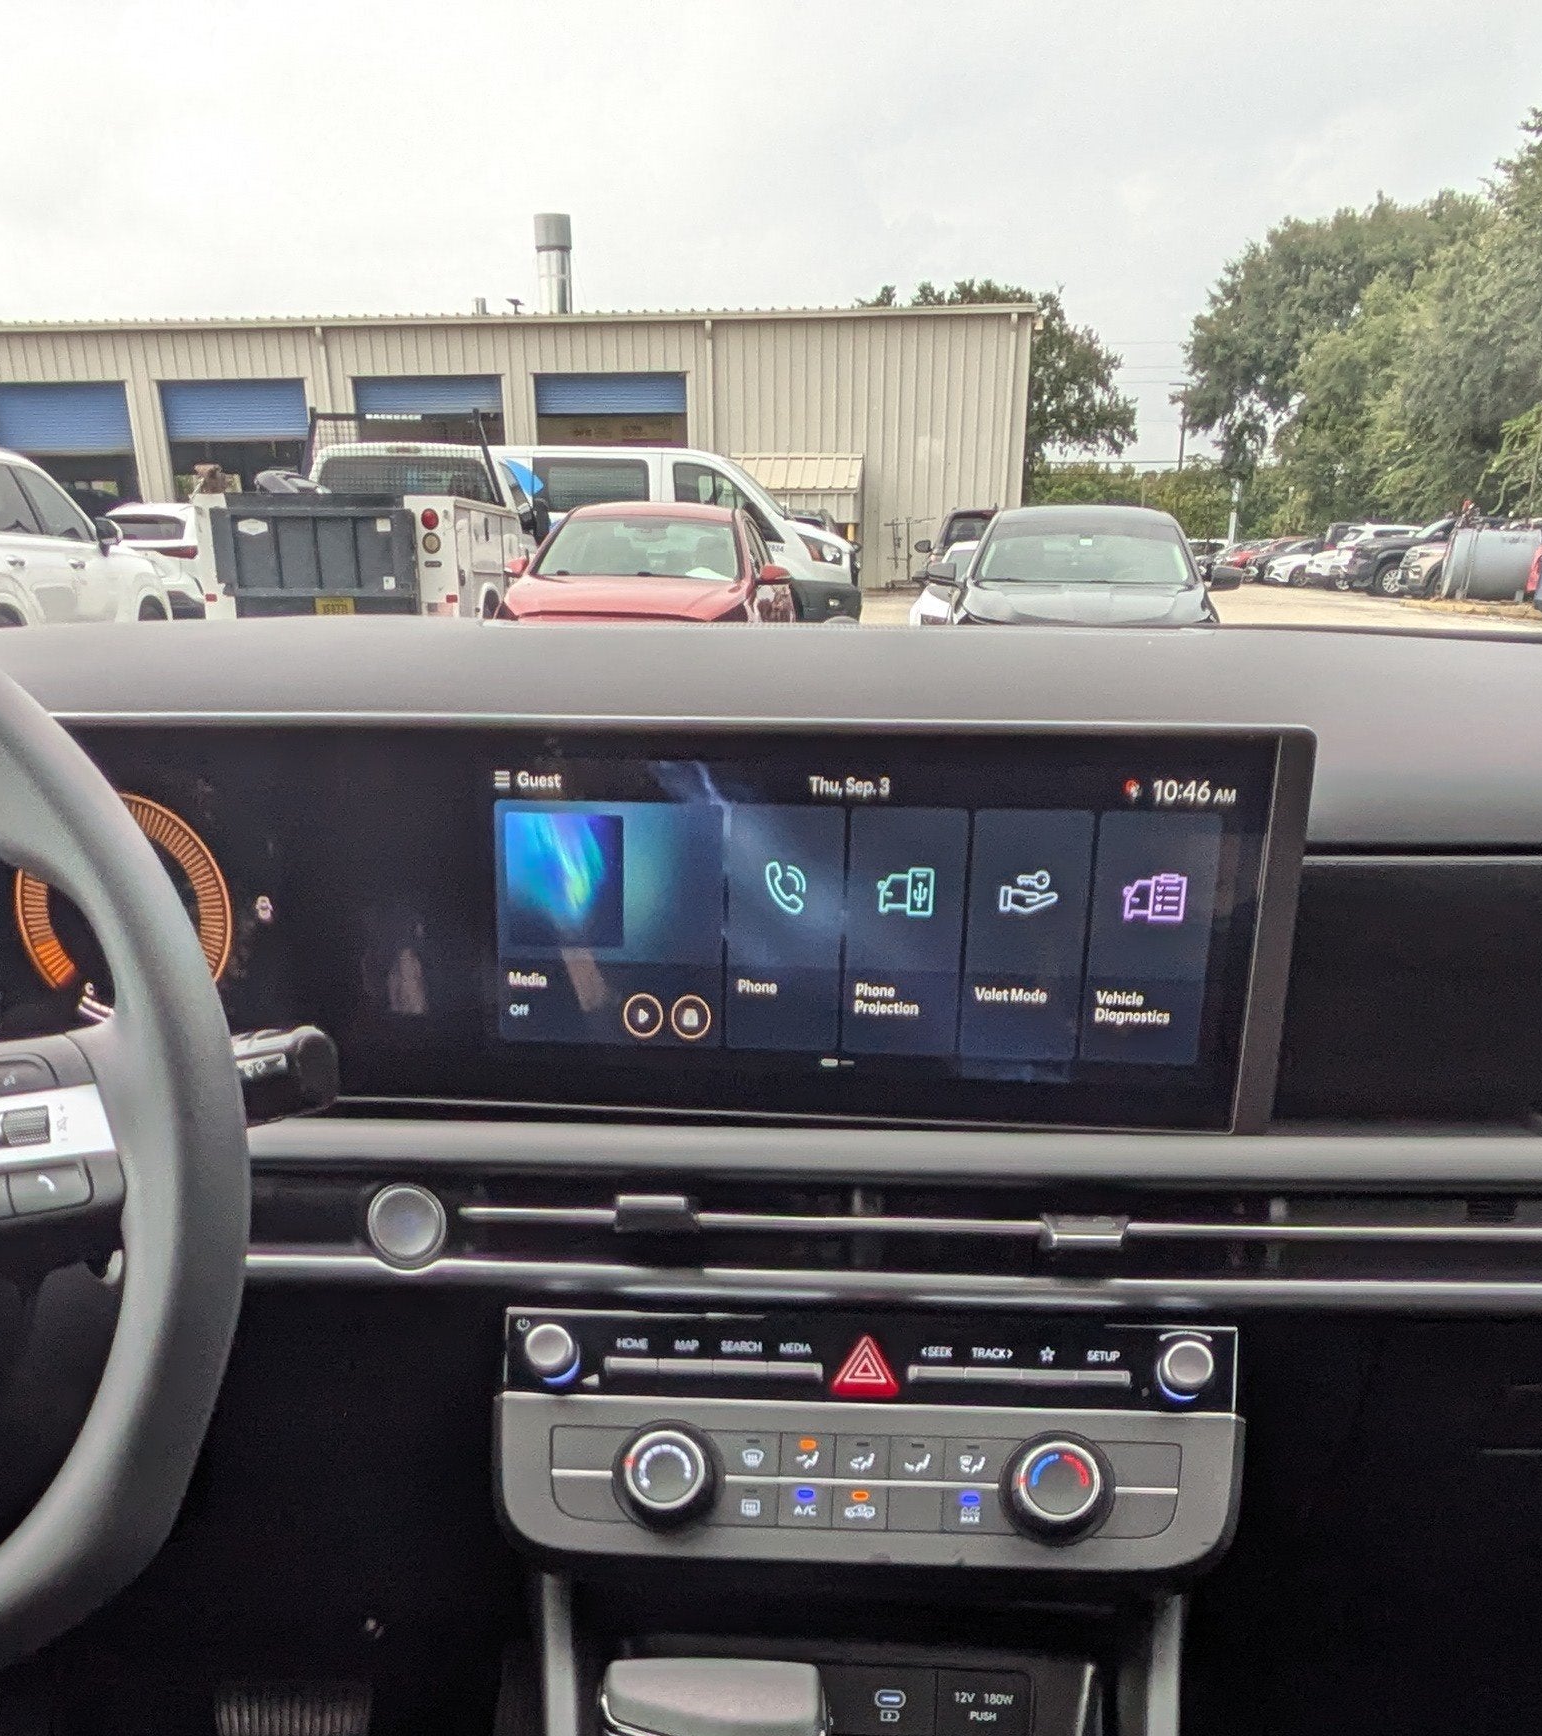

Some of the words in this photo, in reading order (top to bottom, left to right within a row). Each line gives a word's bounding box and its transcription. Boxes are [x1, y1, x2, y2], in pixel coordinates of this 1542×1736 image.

[517, 771, 562, 788] Guest
[809, 775, 843, 797] Thu,
[846, 776, 877, 798] Sep.
[879, 776, 891, 796] 3
[1153, 780, 1211, 803] 10:46
[1213, 788, 1237, 803] AM
[508, 971, 548, 988] Media
[737, 978, 778, 995] Phone
[855, 983, 896, 998] Phone
[975, 986, 1008, 1003] Valet
[1010, 988, 1048, 1003] Mode
[1096, 990, 1144, 1007] Vehicle
[509, 1003, 530, 1017] Off
[854, 999, 920, 1016] Projection
[1094, 1007, 1171, 1026] Diagnostics
[616, 1338, 649, 1350] HOME
[674, 1339, 700, 1351] MAP
[720, 1340, 763, 1353] SEARCH
[779, 1342, 812, 1354] MEDIA
[1086, 1350, 1121, 1362] SETUP
[793, 1505, 817, 1516] A/C
[954, 1691, 976, 1703] 12V
[984, 1693, 1014, 1705] 180W
[969, 1711, 997, 1721] PUSH
